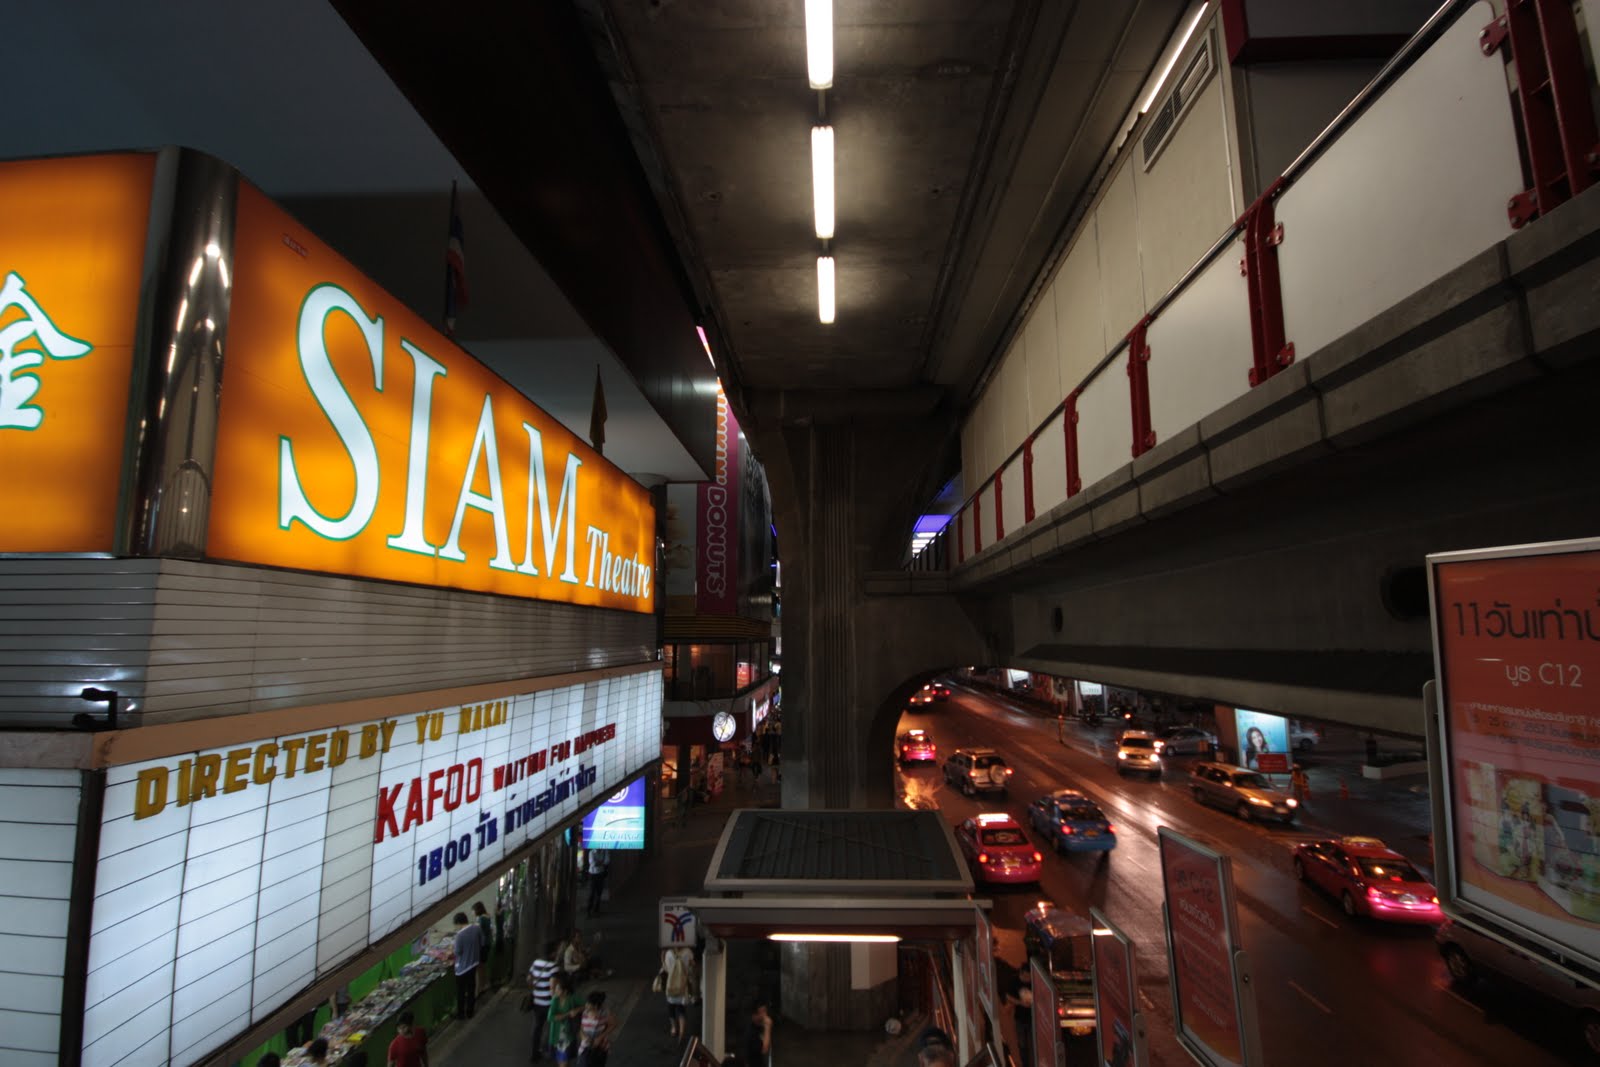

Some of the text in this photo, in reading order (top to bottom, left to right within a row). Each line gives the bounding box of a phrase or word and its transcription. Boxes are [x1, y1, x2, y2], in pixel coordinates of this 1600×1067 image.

[278, 281, 651, 599] SIAM Theatre
[707, 486, 728, 595] DONUTS
[1538, 663, 1583, 688] C12
[134, 701, 509, 822] DIRECTED BY YU NAKAI
[374, 757, 482, 844] KAFOO
[493, 749, 547, 791] WAITING
[550, 740, 571, 766] FOR
[418, 833, 472, 887] 1800
[475, 811, 498, 851] วัน
